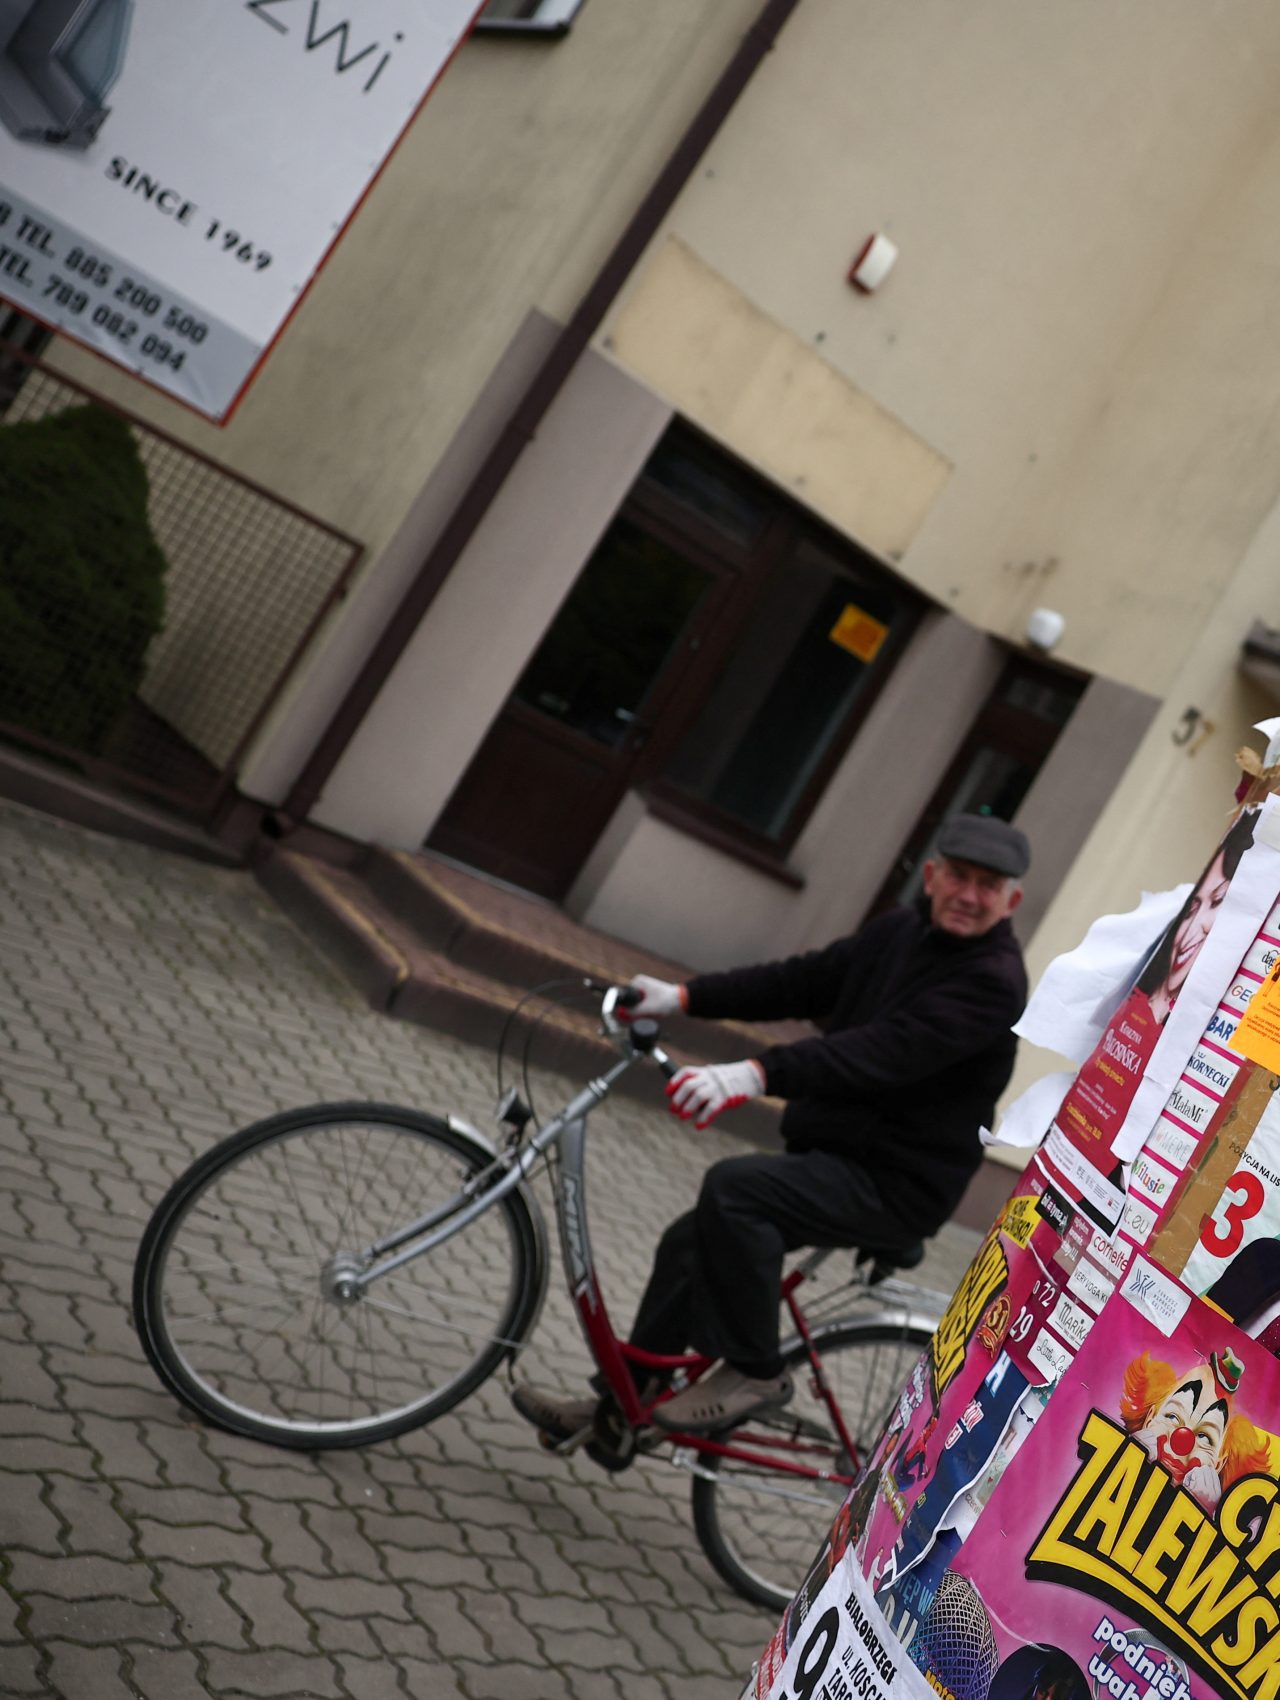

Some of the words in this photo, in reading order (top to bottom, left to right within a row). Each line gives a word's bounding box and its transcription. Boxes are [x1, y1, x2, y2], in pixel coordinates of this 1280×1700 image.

[105, 156, 198, 227] SINCE
[205, 219, 273, 273] 1969
[64, 246, 114, 288] 885
[114, 276, 162, 318] 200
[163, 304, 209, 346] 500
[140, 333, 188, 374] 094
[1187, 1055, 1231, 1089] KORNECKI
[1131, 1158, 1167, 1195] Milusie
[1229, 1142, 1261, 1171] POZYCJA
[1259, 1165, 1271, 1178] NA
[1198, 1170, 1265, 1259] 3
